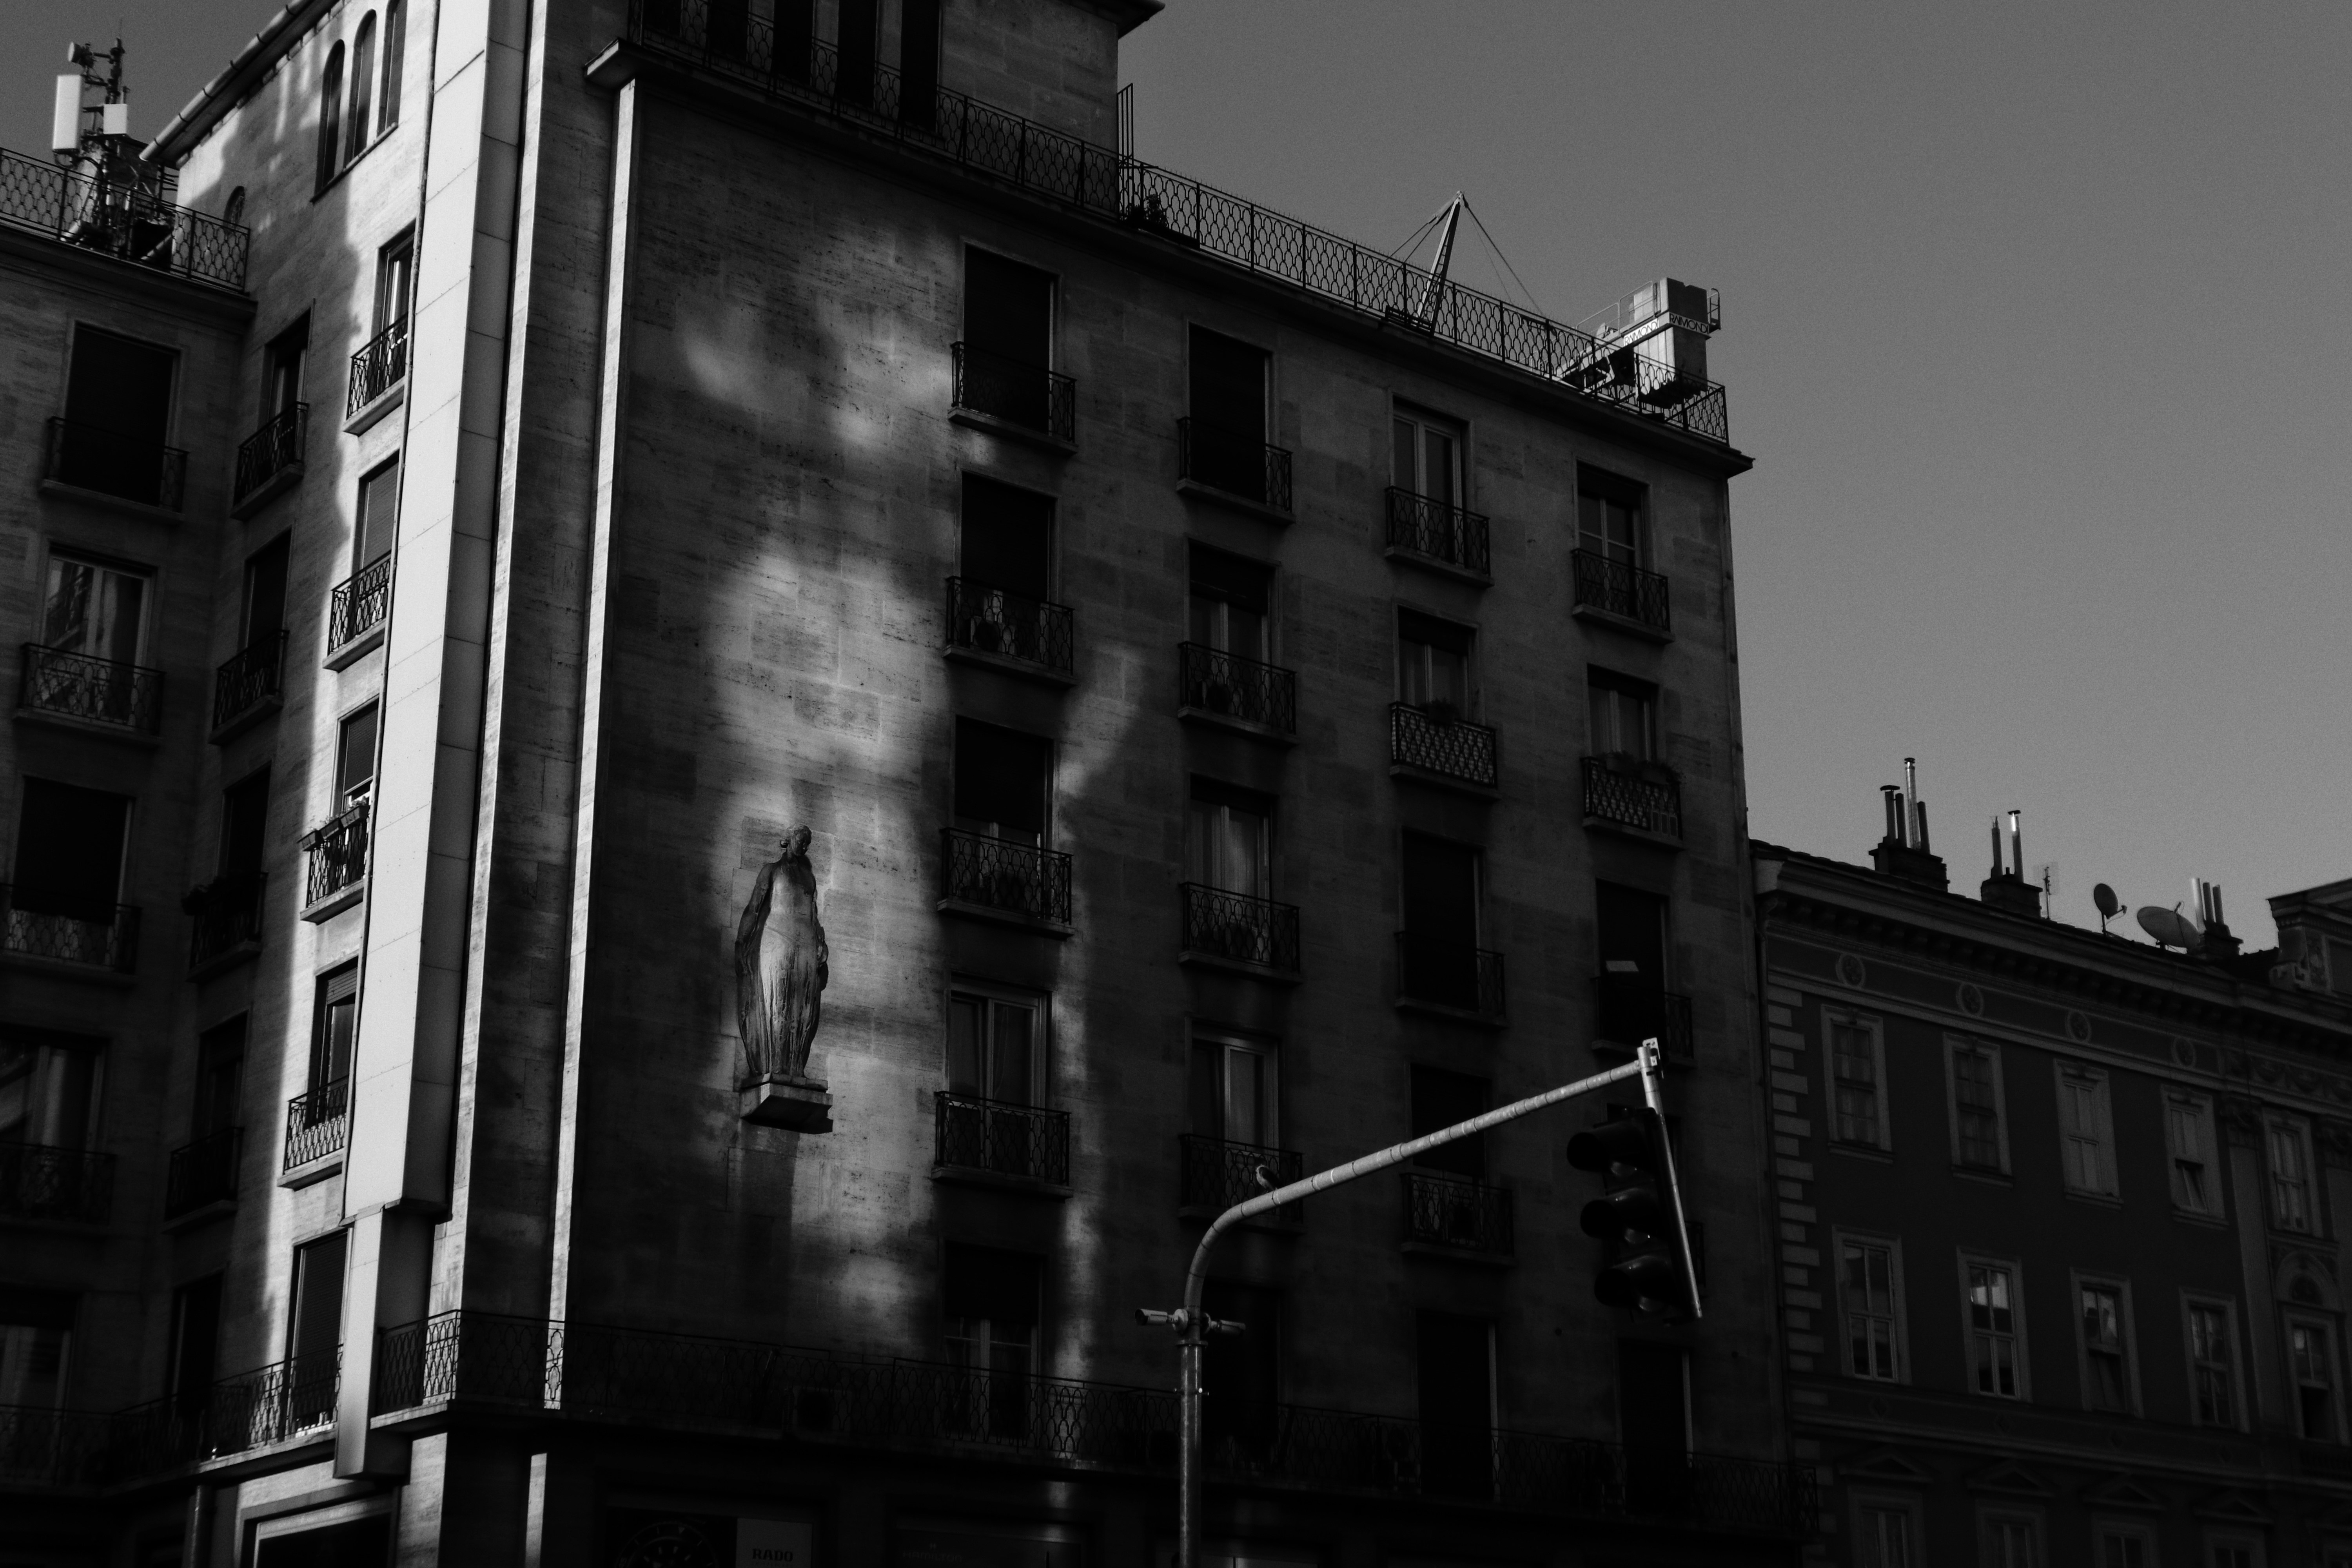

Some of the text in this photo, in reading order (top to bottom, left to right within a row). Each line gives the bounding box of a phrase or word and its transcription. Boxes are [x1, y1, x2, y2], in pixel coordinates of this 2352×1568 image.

[1624, 318, 1659, 345] RAIMONDI
[1670, 313, 1708, 334] RAIMONDI
[752, 1549, 793, 1562] RADO
[902, 1551, 962, 1562] HAMILTON
